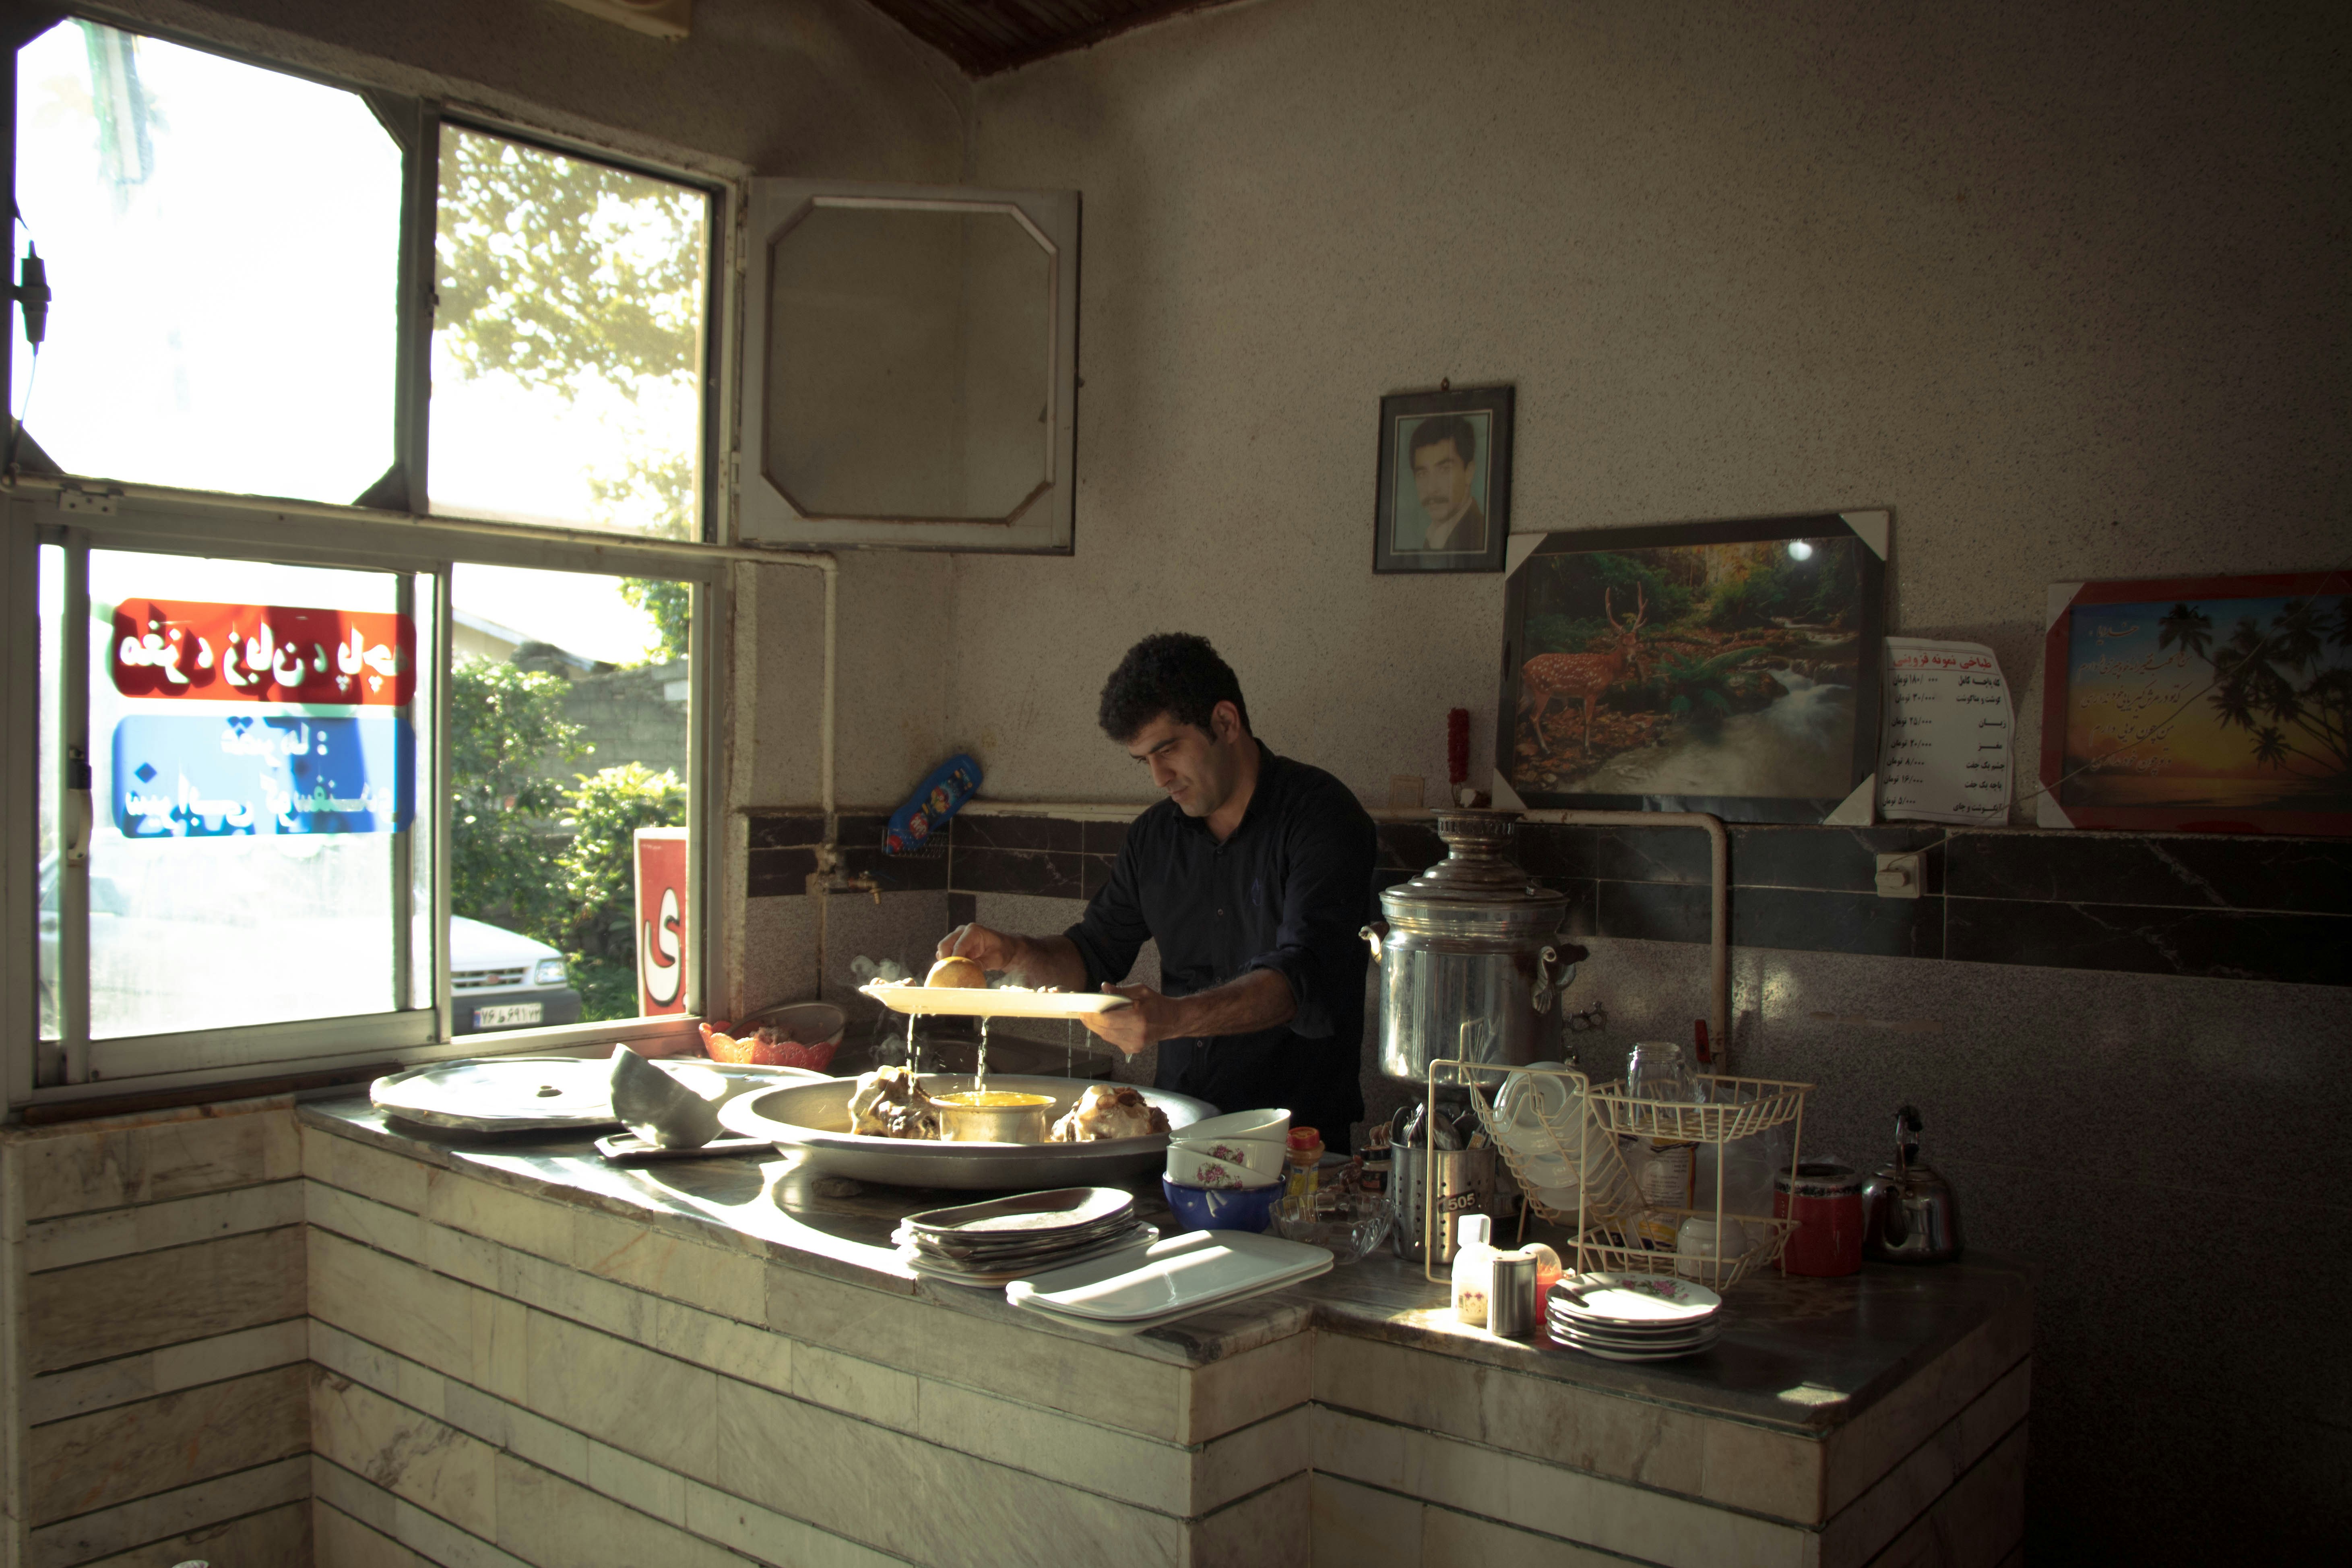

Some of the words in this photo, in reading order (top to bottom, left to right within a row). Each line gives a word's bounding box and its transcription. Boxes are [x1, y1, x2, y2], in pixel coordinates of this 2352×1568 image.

[2096, 621, 2140, 646] خدایا
[1893, 652, 1929, 667] قزوینی
[1932, 654, 1956, 668] نمونه
[1960, 657, 1992, 670] طباخی
[1892, 674, 1908, 686] تومان
[1958, 675, 1970, 687] کامل
[1894, 692, 1910, 704] تومان
[1985, 695, 2001, 705] گوشت
[1891, 717, 1907, 727] تومان
[2088, 725, 2116, 748] دارم
[2152, 725, 2174, 740] من
[1891, 738, 1907, 749] تومان
[1977, 742, 2003, 752] مغز
[1886, 757, 1903, 767] تومان
[1966, 761, 1980, 771] جفت
[1980, 761, 1991, 771] یک
[1991, 762, 2005, 772] چشم
[1883, 775, 1899, 785] تومان
[1964, 780, 1978, 791] جفت
[1979, 780, 1988, 791] یک
[1881, 796, 1896, 807] تومان
[1953, 802, 1966, 812] چای
[1448, 1192, 1475, 1211] 505
